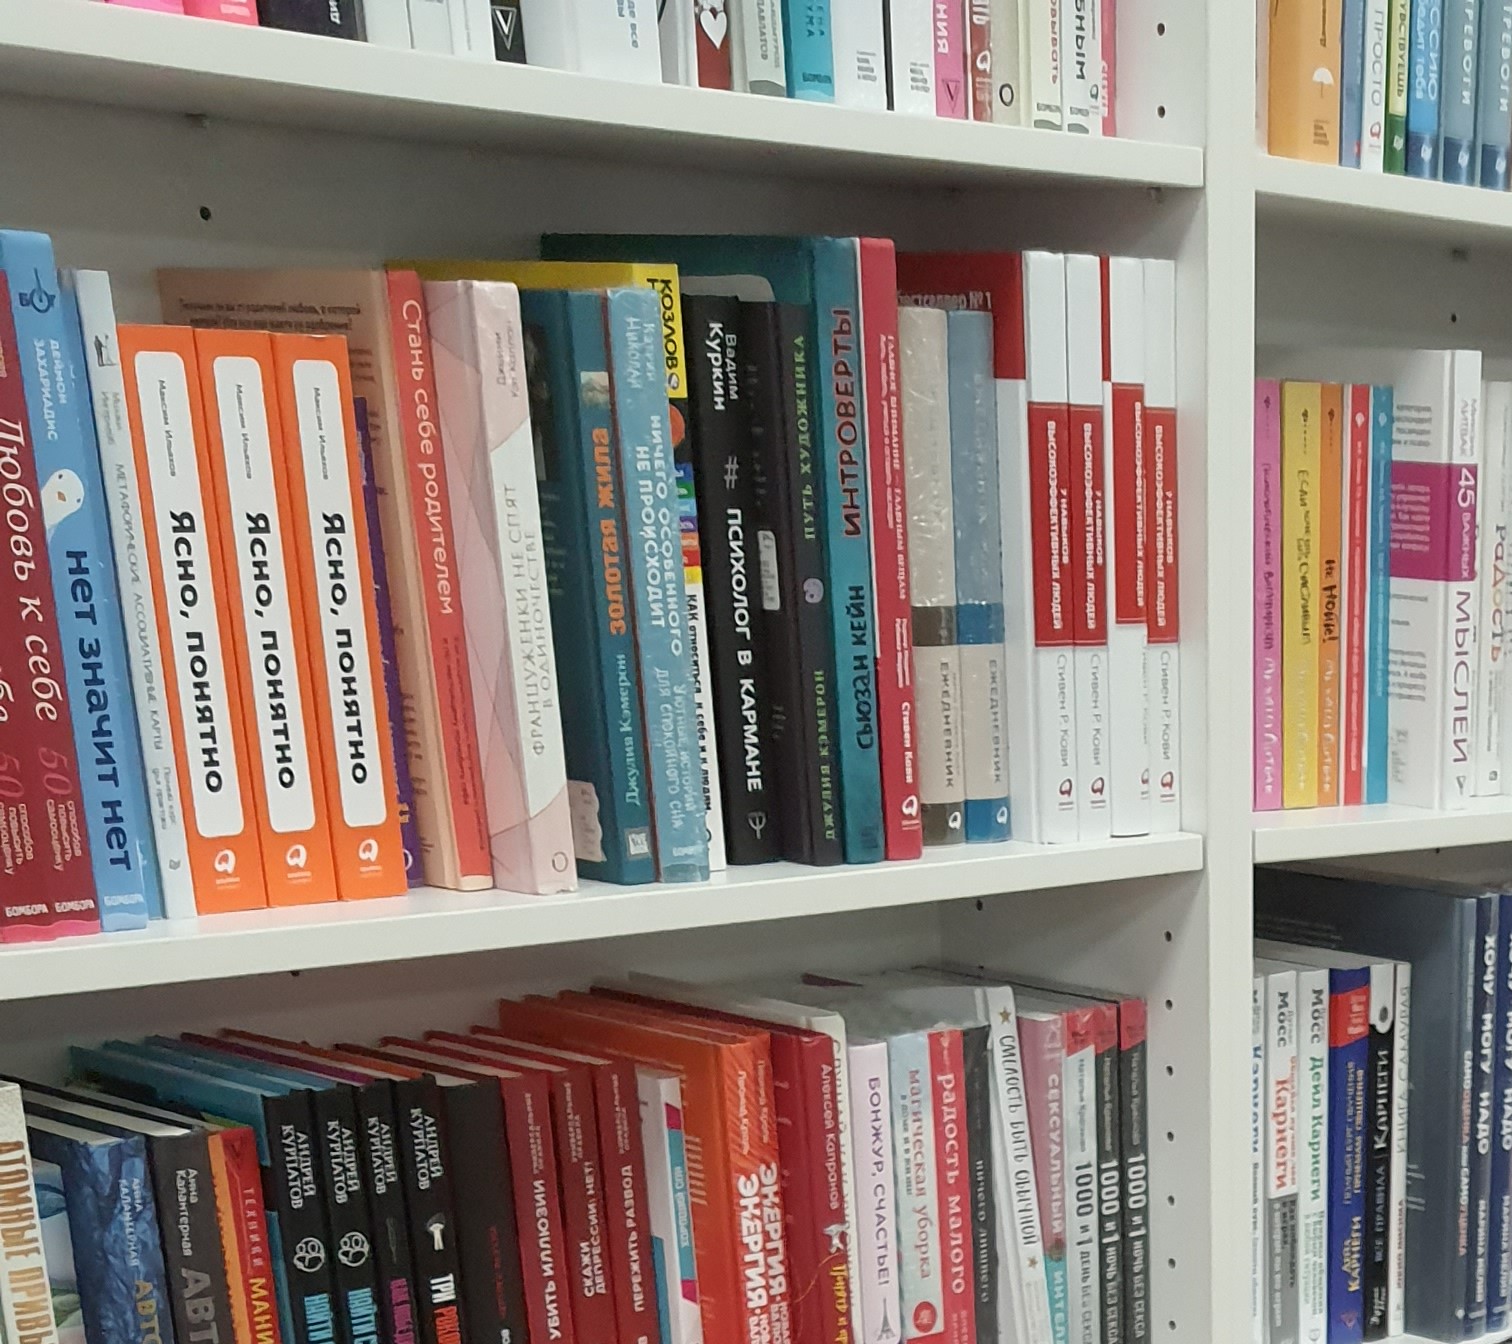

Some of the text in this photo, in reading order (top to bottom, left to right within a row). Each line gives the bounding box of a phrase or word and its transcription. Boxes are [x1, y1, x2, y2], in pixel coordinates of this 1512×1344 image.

[1371, 9, 1384, 107] ПРОСТО
[658, 279, 681, 371] КОЗЛОВ
[705, 322, 726, 411] Куркин
[725, 335, 739, 401] Вадим
[402, 299, 454, 615] Стань себе родителем
[793, 336, 816, 540] ПУТЬ ХУДОЖНИКА
[832, 308, 861, 539] ИНТРОВЕРТЫ
[1457, 467, 1475, 509] 45
[0, 418, 36, 581] Любовь
[24, 633, 64, 722] себе
[727, 507, 751, 640] ПСИХОЛОГ
[186, 631, 223, 793] понятно
[517, 590, 545, 756] ФРАНЦУЖЕНКИ
[848, 584, 875, 752] СЬЮЗАН КЕЙН
[738, 678, 762, 792] КАРМАНЕ
[812, 670, 835, 840] ДЖУЛИЯ КЭМЕРОН
[940, 661, 954, 789] ЕЖЕДНЕВНИК
[1277, 991, 1289, 1048] Мосс
[1311, 988, 1323, 1045] Мосс
[1478, 934, 1497, 1155] ХОЧУ МОГУ НАДО
[281, 1124, 304, 1209] КУРПАТОВ
[296, 1132, 316, 1197] АНДРЕЙ
[327, 1120, 348, 1205] КУРПАТОВ
[341, 1128, 361, 1192] АНДРЕЙ
[868, 1077, 885, 1177] БОНЖУР,
[999, 1034, 1039, 1248] СМЕЛОСТЬ БЫТЬ ОБЫЧНОЙ
[1271, 1078, 1290, 1190] Карнеги
[1306, 1056, 1325, 1201] Дейл Карнеги
[1501, 1087, 1512, 1151] НАДО
[532, 1179, 555, 1276] ИЛЛЮЗИИ
[621, 1164, 638, 1229] РАЗВОД
[544, 1281, 562, 1341] УБИТЬ
[577, 1241, 595, 1298] СКАЖИ
[626, 1230, 645, 1312] ПЕРЕЖИТЬ
